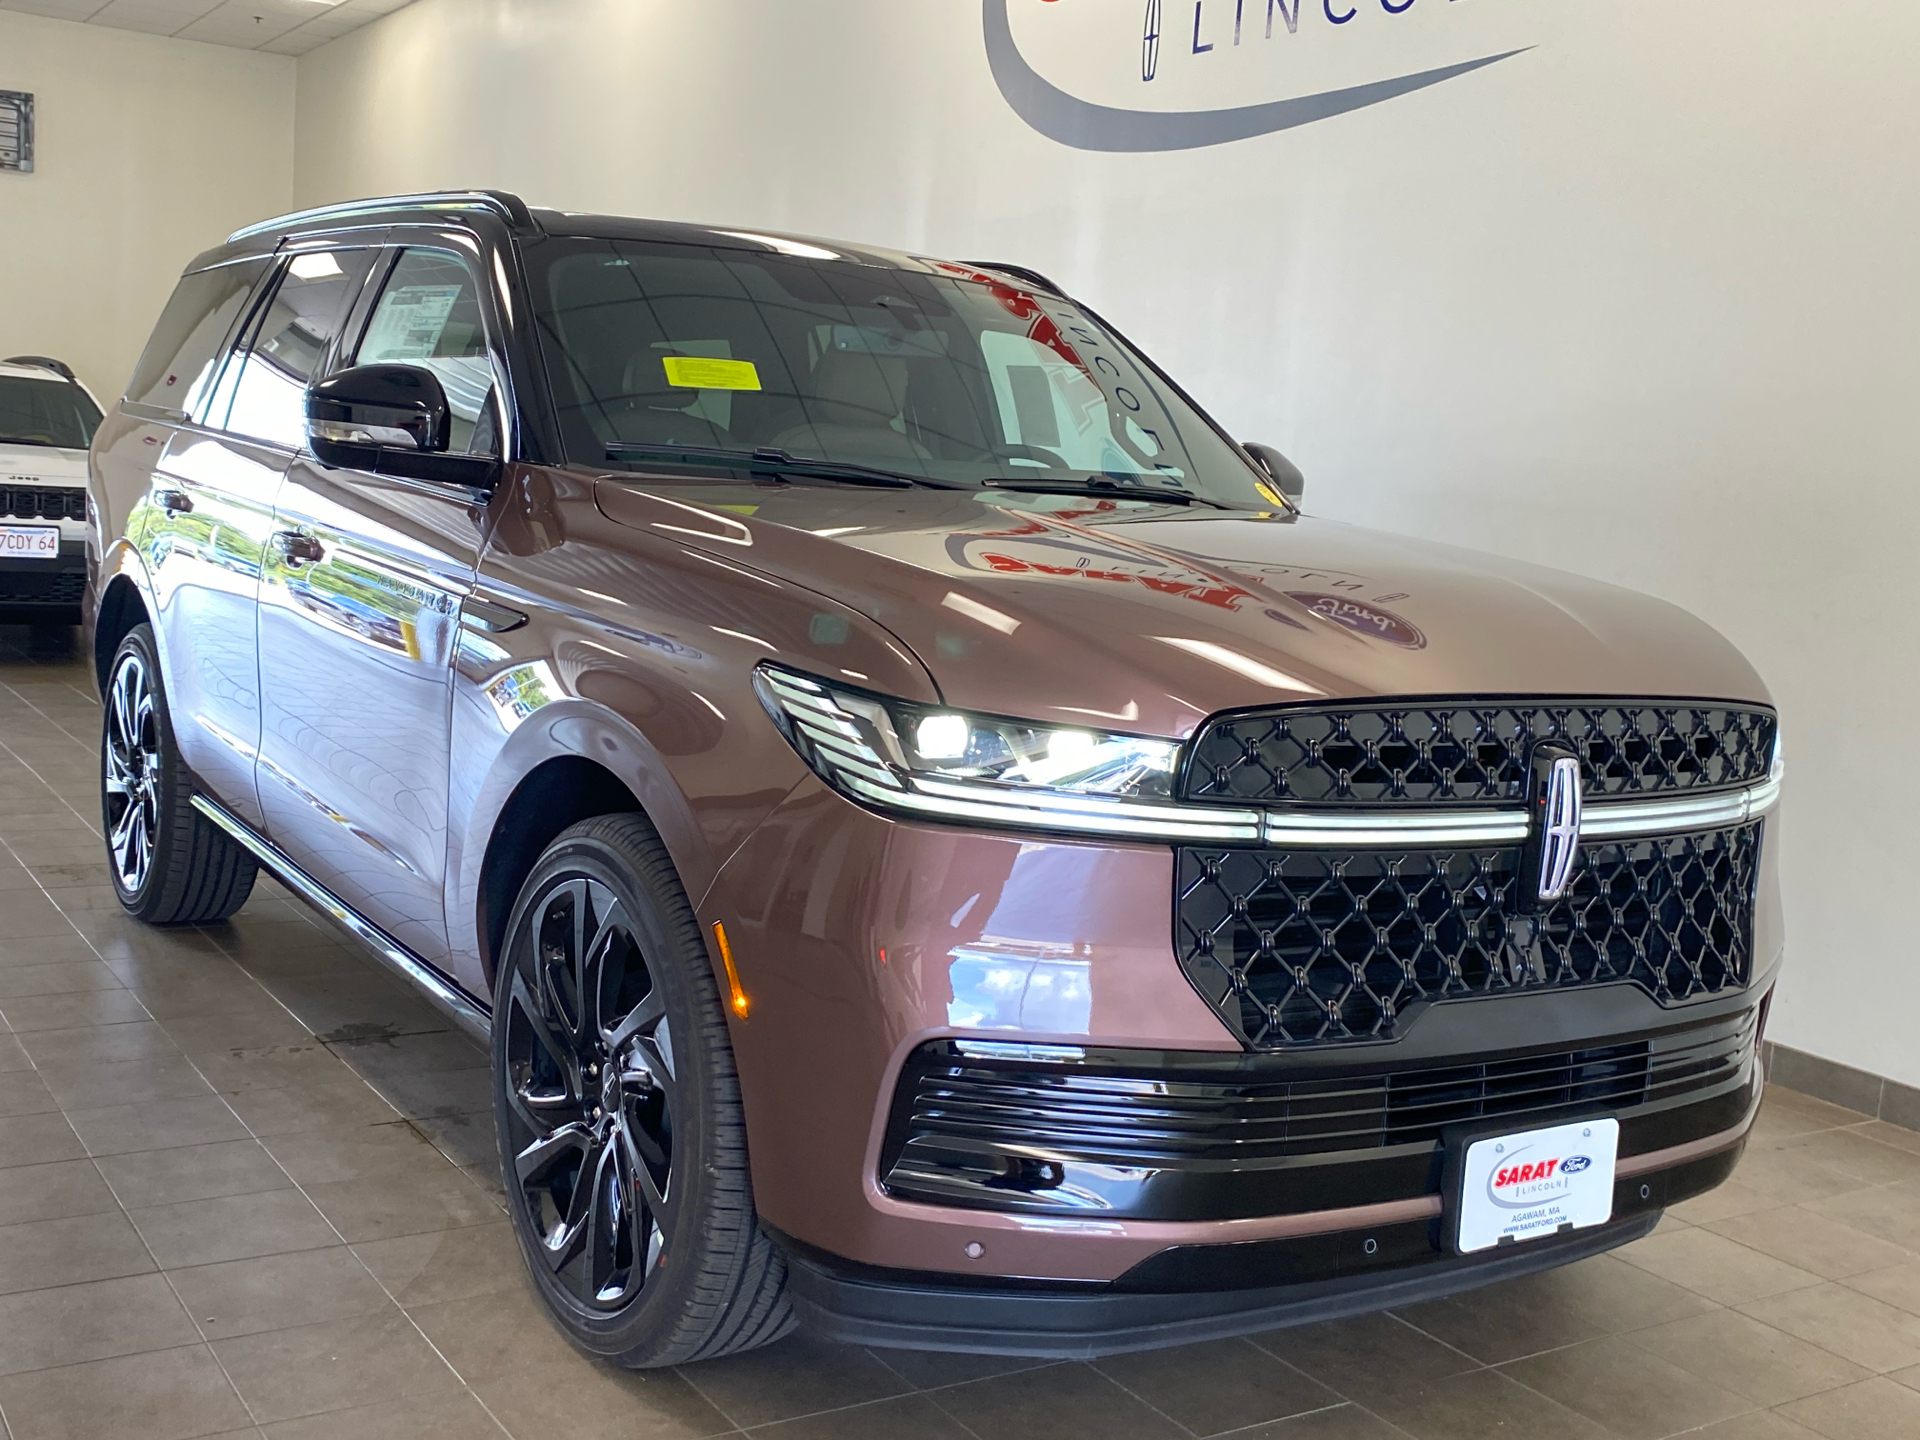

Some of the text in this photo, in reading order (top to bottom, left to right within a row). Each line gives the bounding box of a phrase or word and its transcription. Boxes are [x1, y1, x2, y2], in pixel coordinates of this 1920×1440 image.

[38, 535, 55, 551] 64
[1494, 1157, 1588, 1188] SARAT Ford
[1521, 1180, 1562, 1194] LINCOLN
[1511, 1206, 1560, 1223] AGAWAM, MA
[1503, 1215, 1567, 1233] WWW.SARATFORD.COM
